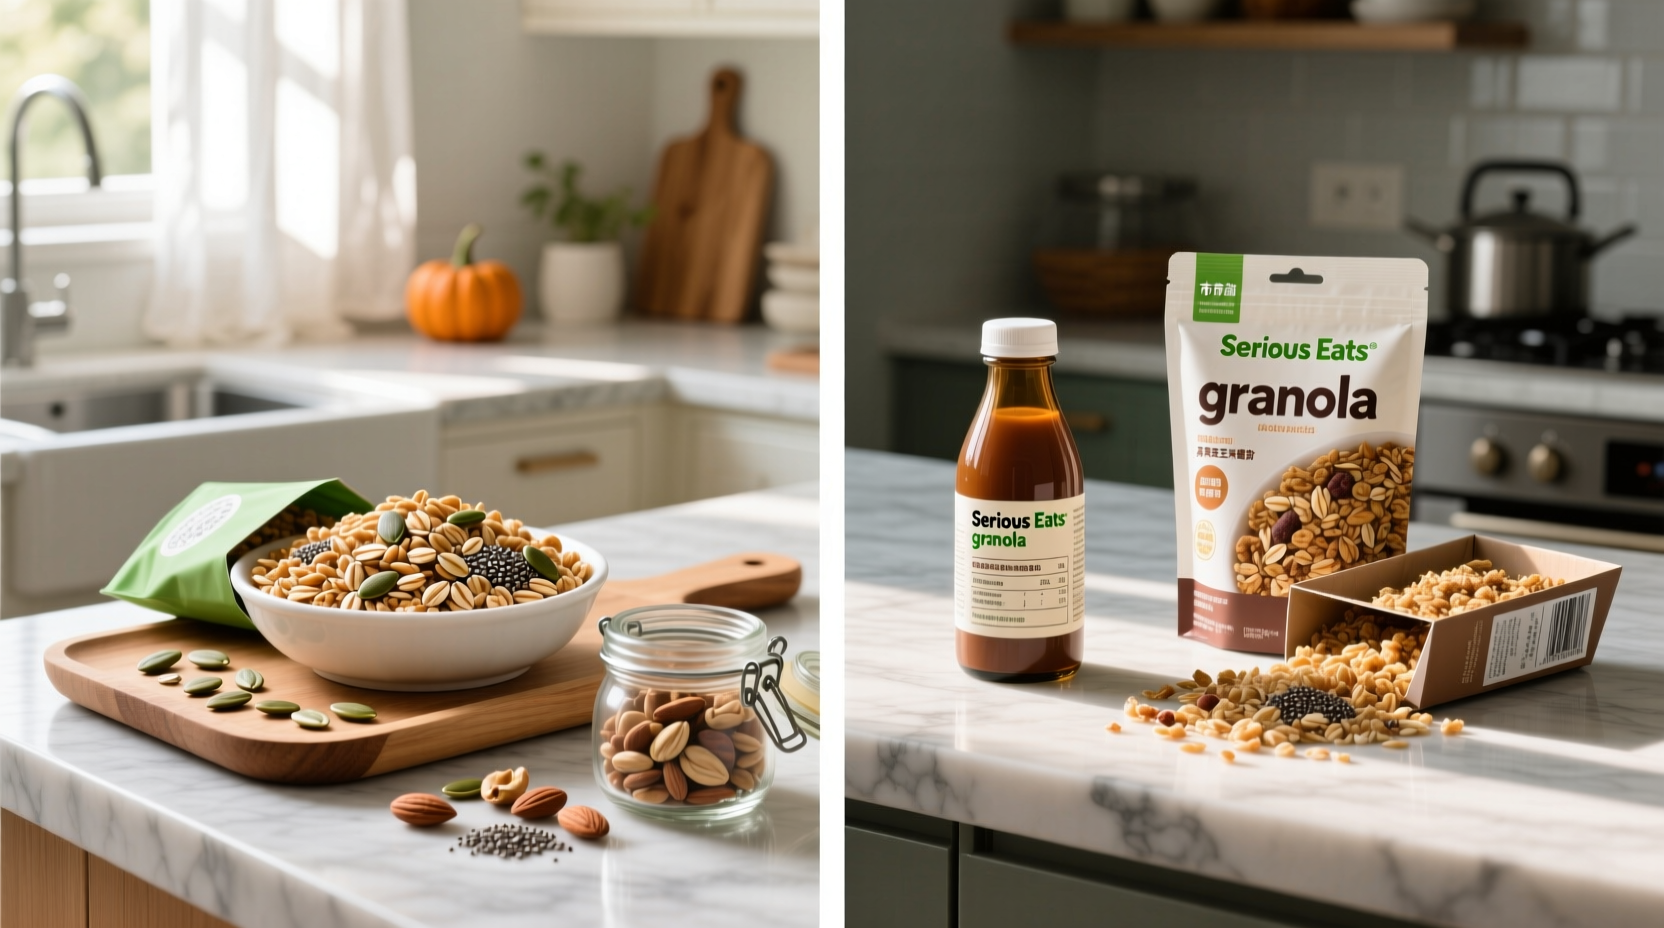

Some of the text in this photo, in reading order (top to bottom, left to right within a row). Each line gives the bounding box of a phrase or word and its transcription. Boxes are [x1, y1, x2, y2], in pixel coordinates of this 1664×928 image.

[1220, 334, 1311, 360] Serious
[1199, 375, 1377, 426] granola
[971, 510, 1031, 529] Serious
[971, 531, 1027, 550] granola
